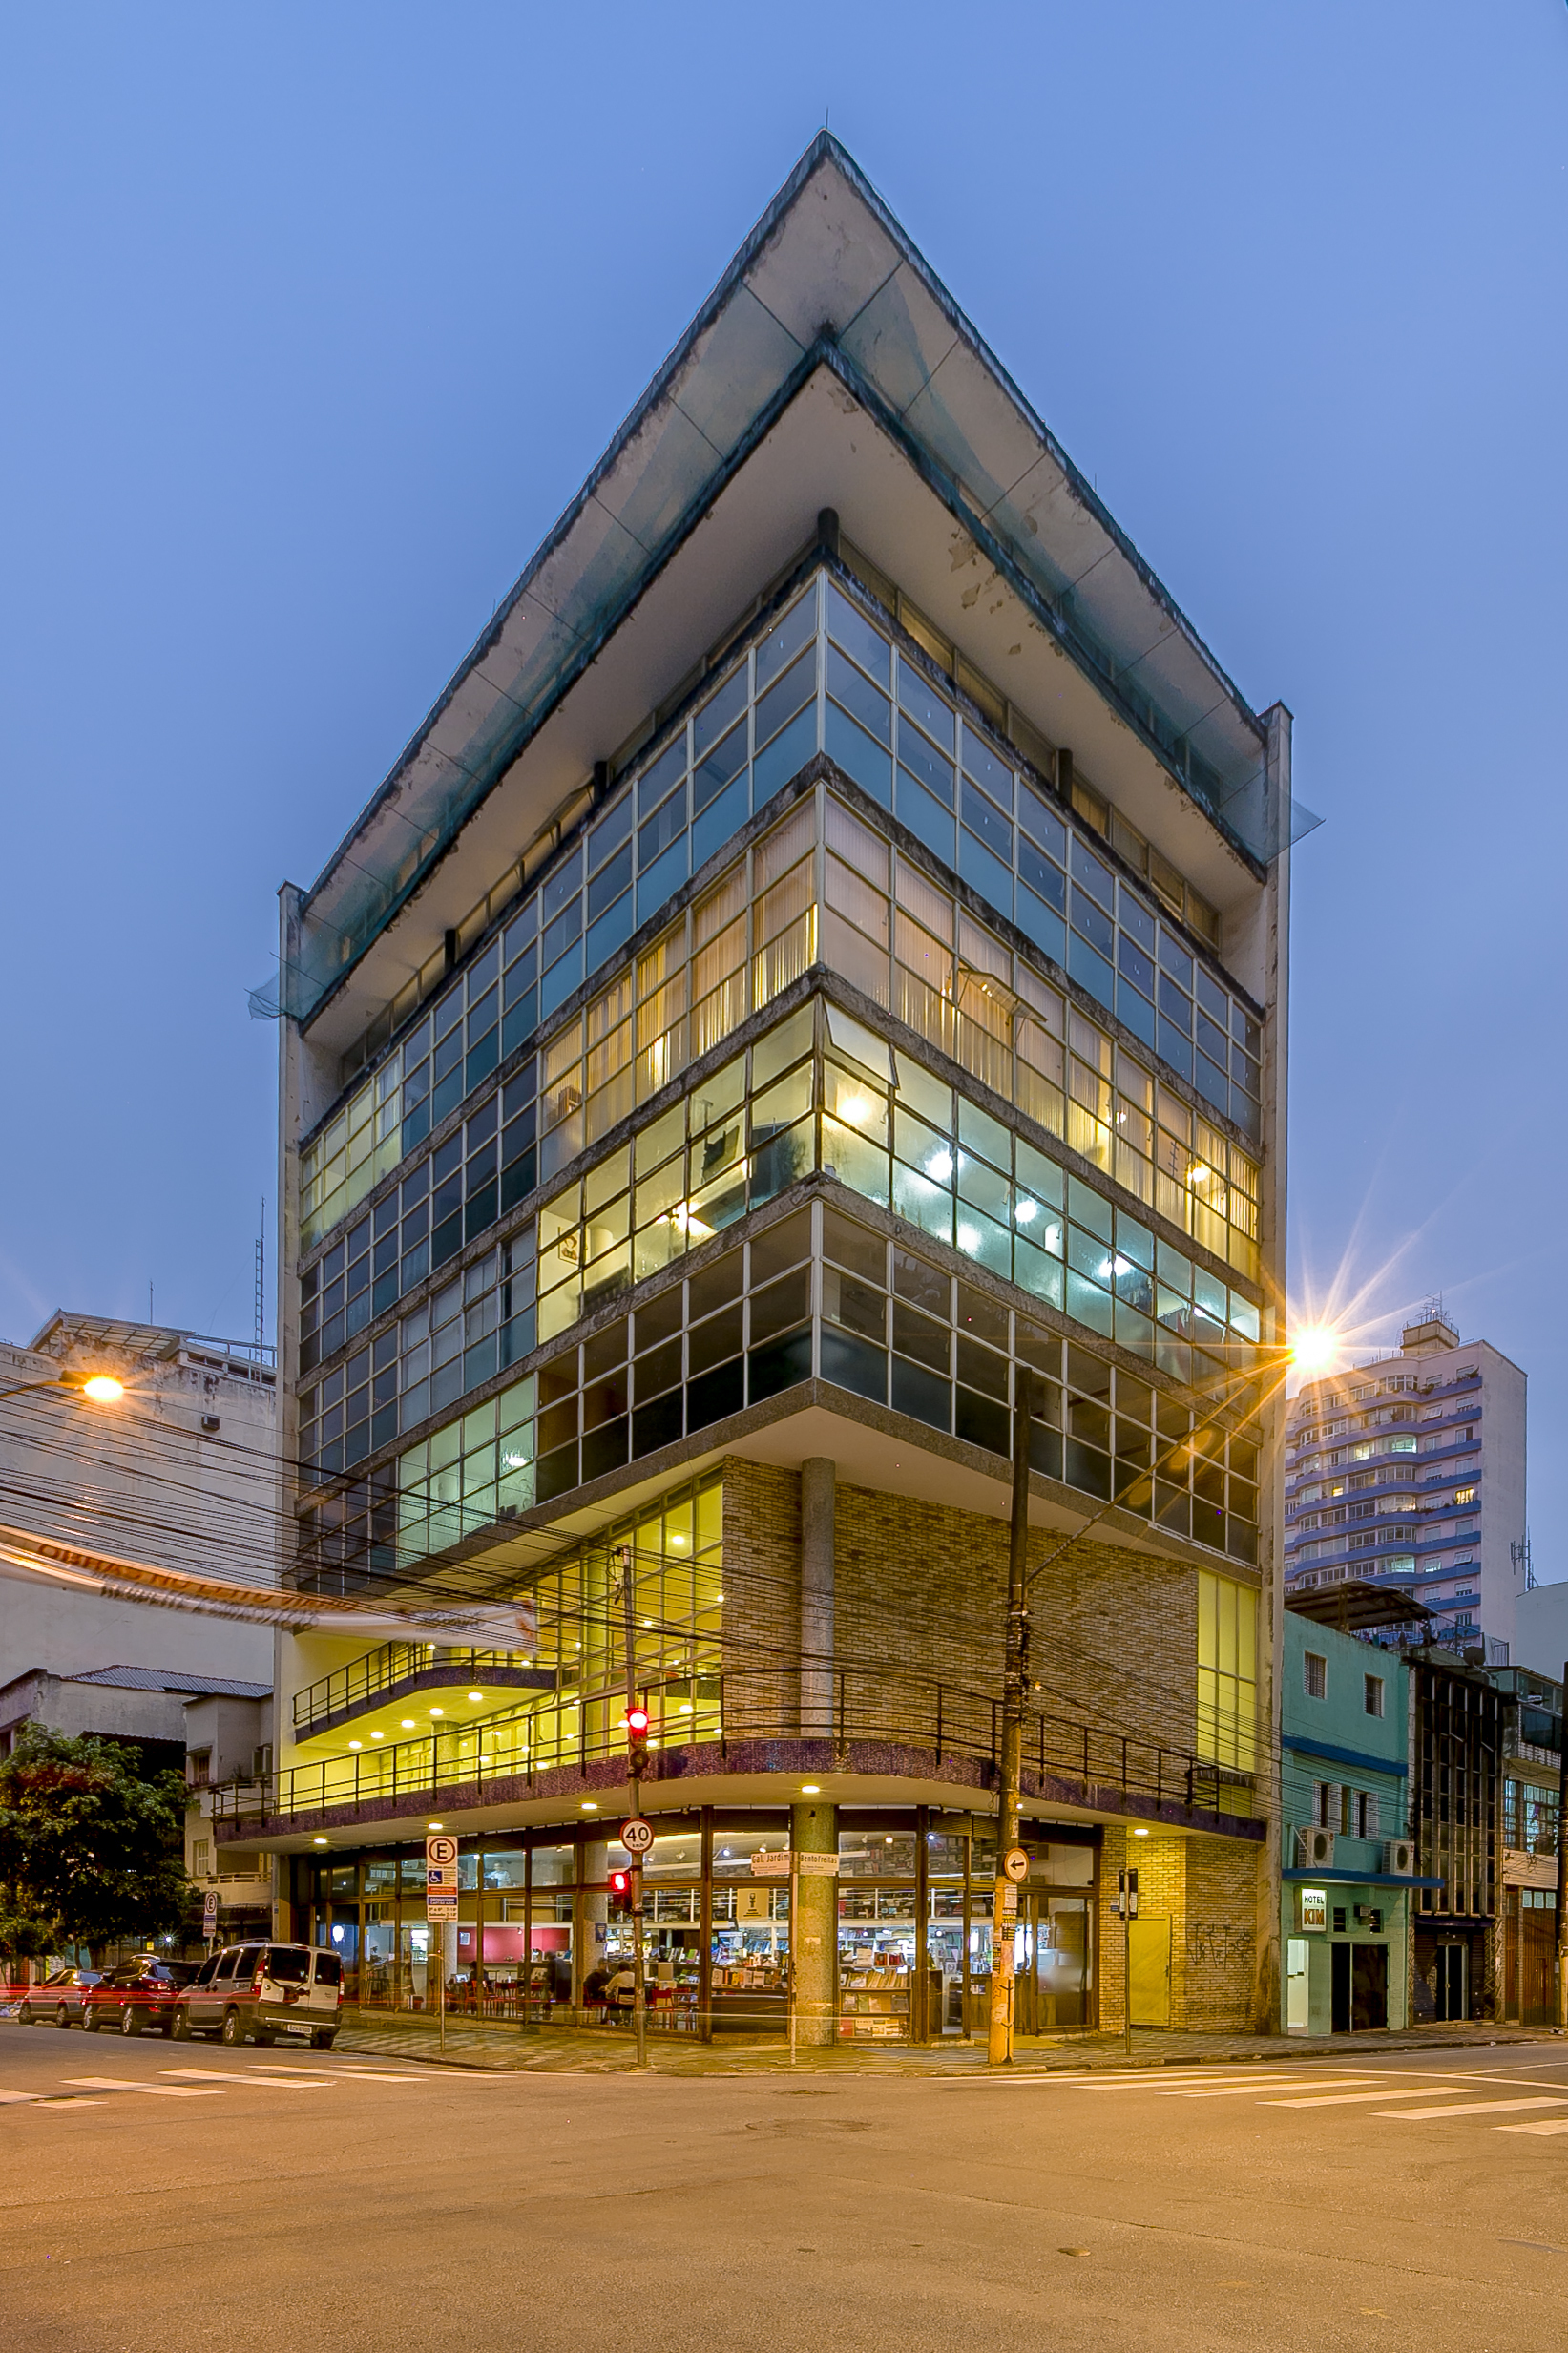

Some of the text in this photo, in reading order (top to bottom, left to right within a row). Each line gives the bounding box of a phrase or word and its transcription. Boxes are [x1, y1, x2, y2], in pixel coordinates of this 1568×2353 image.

[625, 1826, 649, 1842] 40
[437, 1843, 448, 1859] E
[766, 1852, 789, 1863] Jardim
[800, 1854, 838, 1864] Bento Freitas
[1304, 1896, 1324, 1904] HOTEL
[1304, 1908, 1324, 1925] KIM
